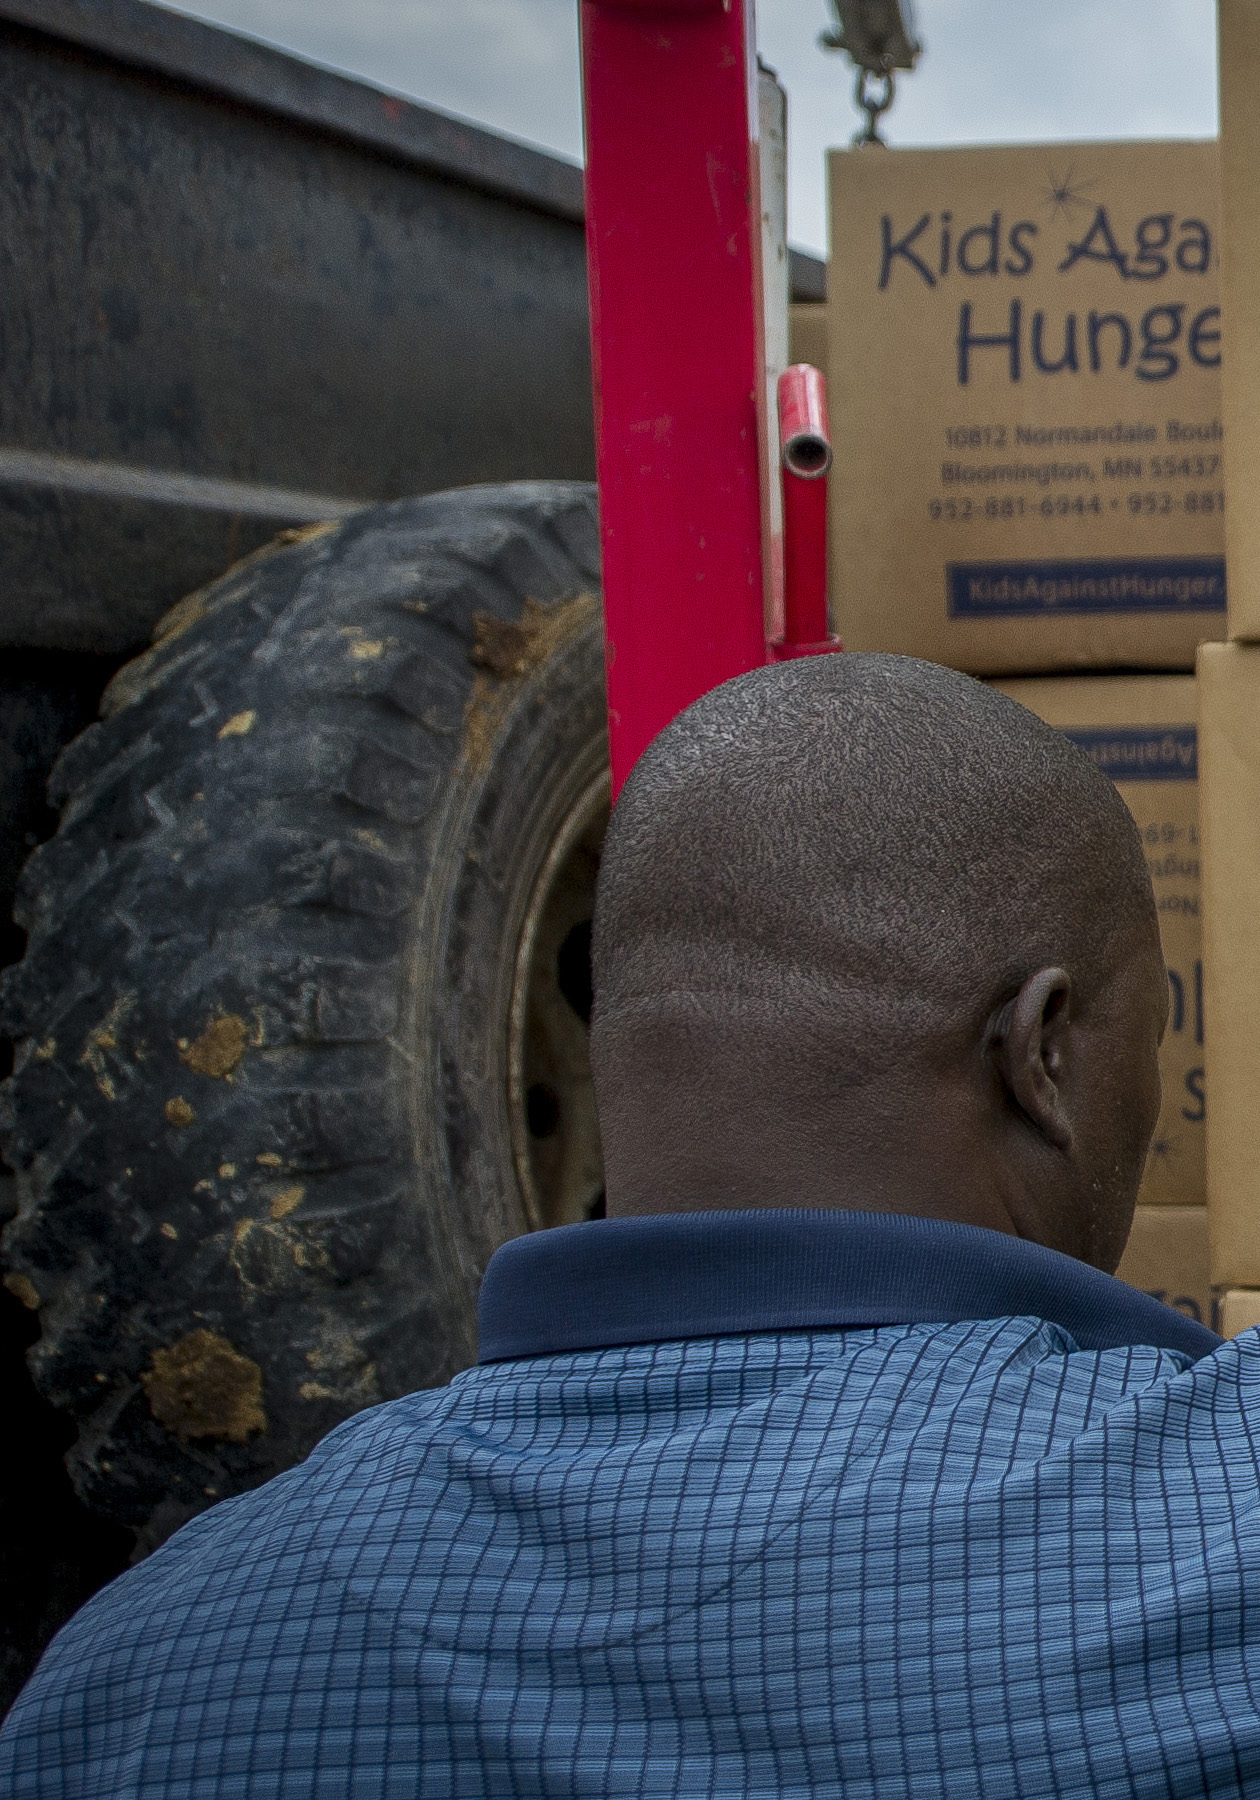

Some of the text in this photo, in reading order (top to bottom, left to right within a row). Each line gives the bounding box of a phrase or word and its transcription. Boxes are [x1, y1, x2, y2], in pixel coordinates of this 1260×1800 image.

[878, 210, 1039, 292] Kids
[945, 424, 1007, 447] 10812
[1015, 421, 1157, 444] Normandale
[1103, 456, 1142, 478] MN
